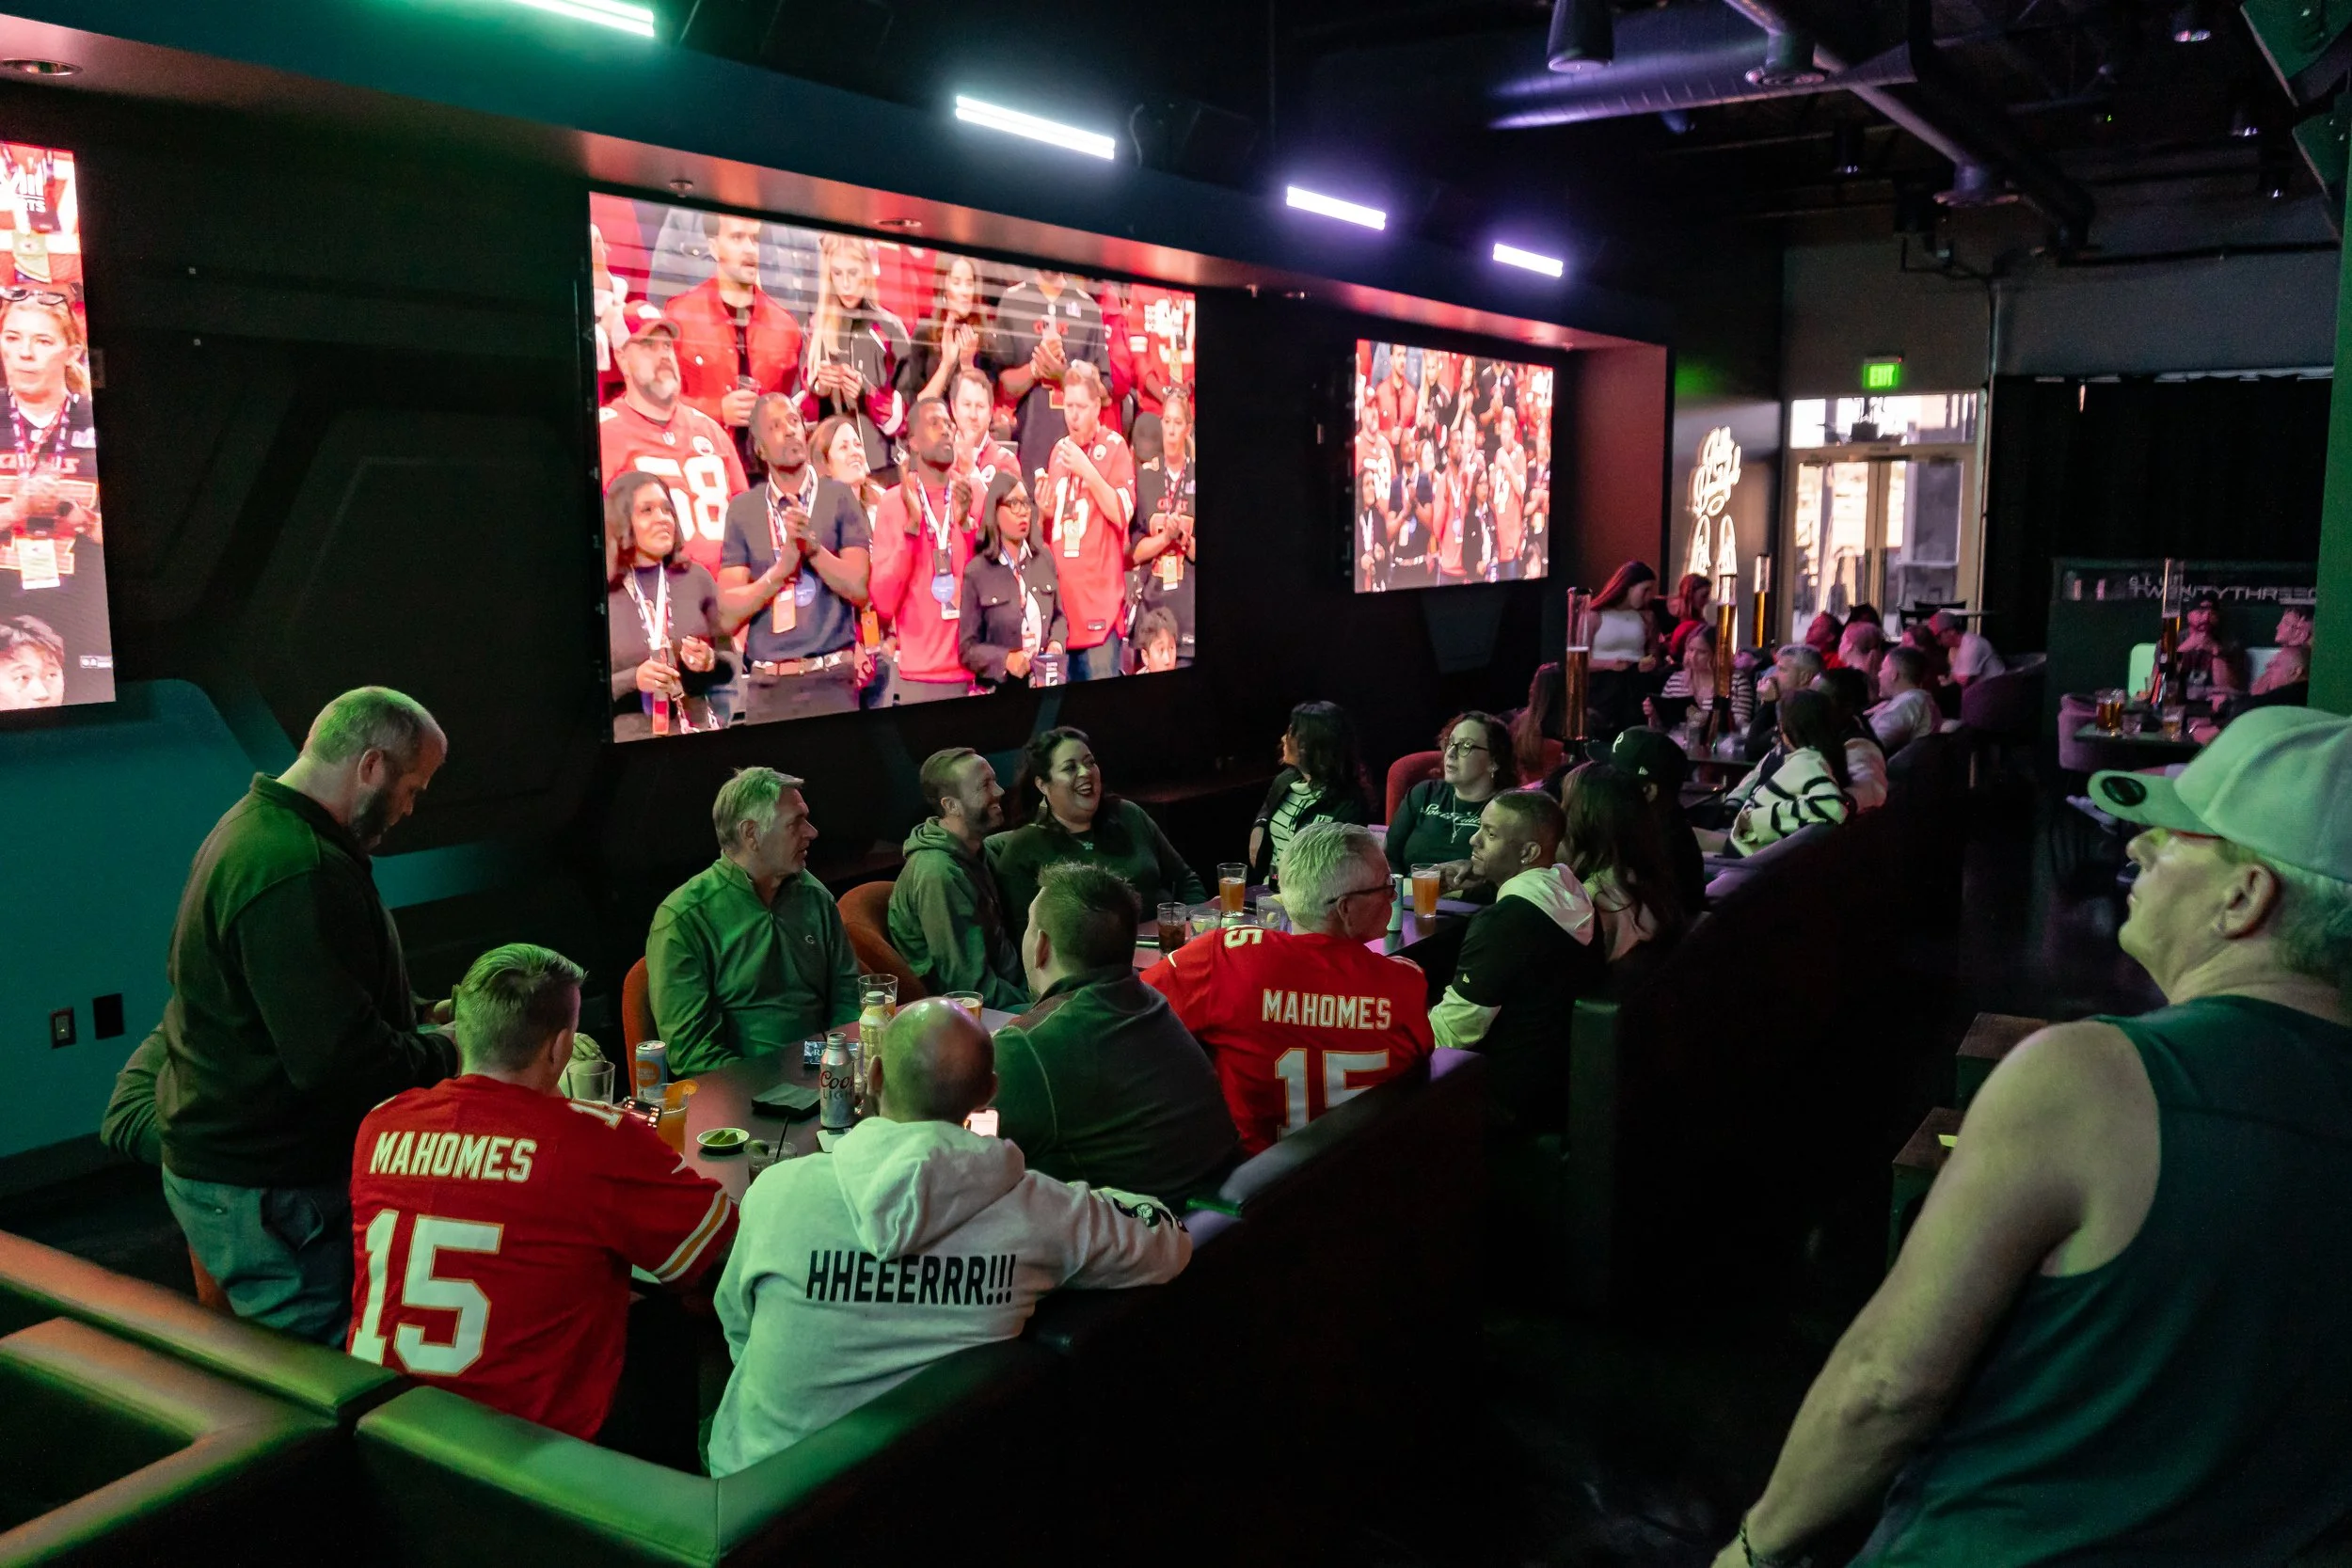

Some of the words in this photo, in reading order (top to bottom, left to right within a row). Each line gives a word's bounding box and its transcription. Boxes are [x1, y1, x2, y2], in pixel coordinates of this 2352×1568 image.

[1869, 364, 1895, 388] EXIT
[1262, 988, 1392, 1031] MAHOMES
[820, 1070, 854, 1090] Coo
[369, 1131, 537, 1183] MAHOMES
[350, 1208, 504, 1377] 15
[805, 1249, 1017, 1307] HHEEERRR!!!
